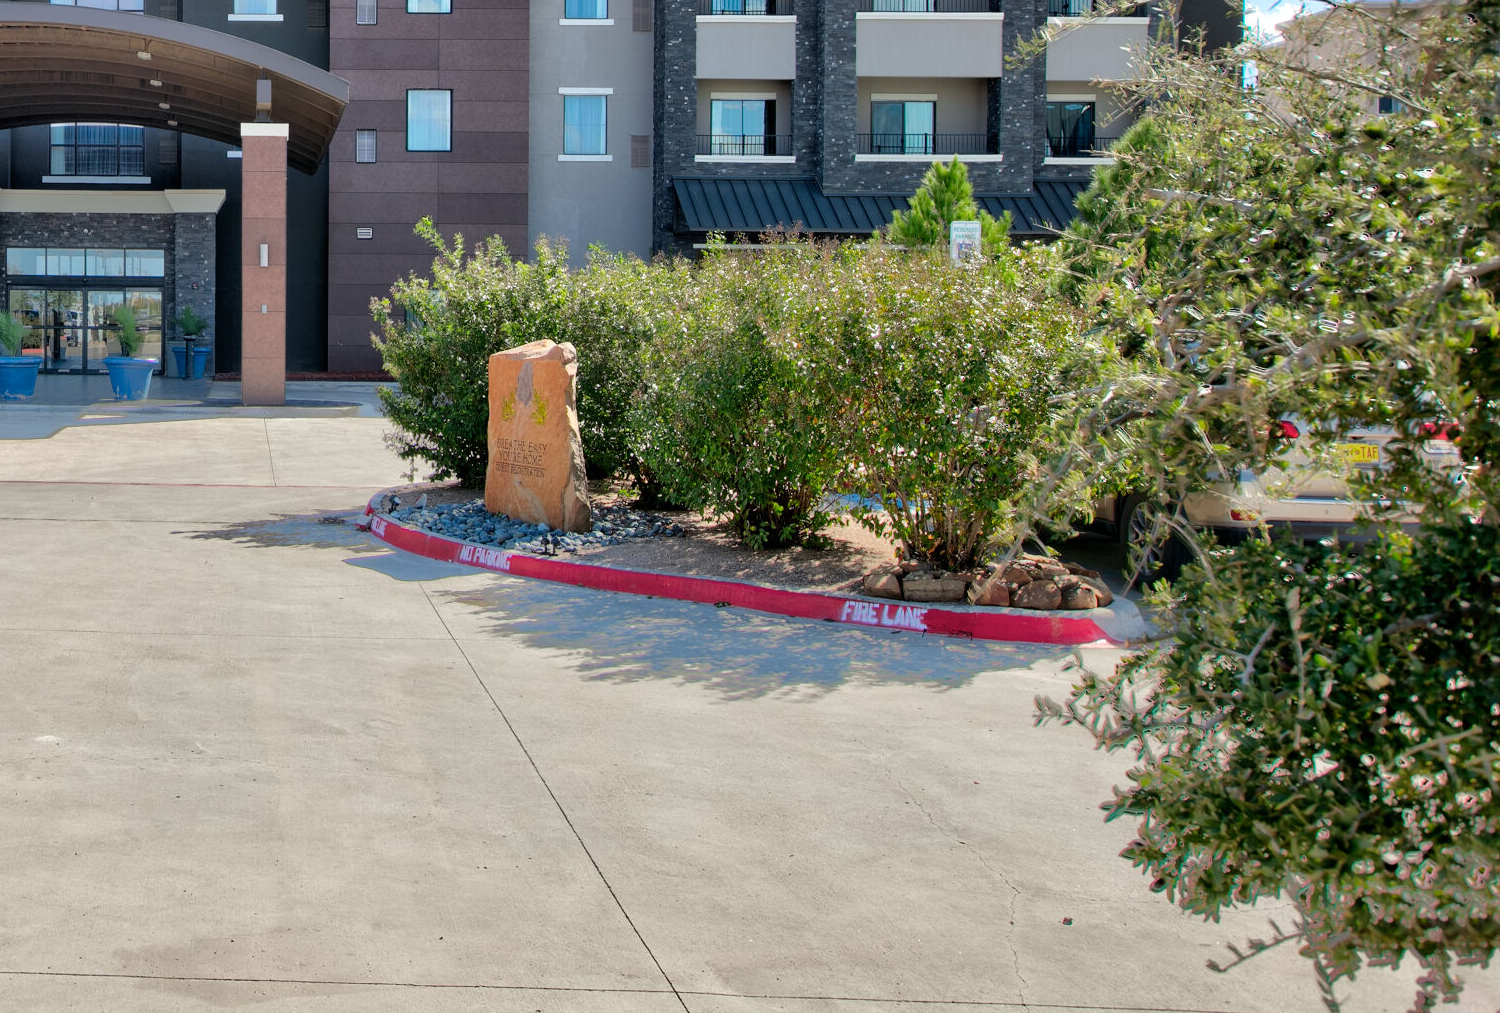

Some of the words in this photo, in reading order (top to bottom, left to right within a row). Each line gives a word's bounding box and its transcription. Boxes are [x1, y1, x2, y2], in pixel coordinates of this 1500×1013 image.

[497, 438, 526, 452] BREATHE
[528, 441, 548, 455] EASY
[522, 453, 543, 467] HOME
[460, 544, 474, 561] NO
[473, 547, 512, 571] PARKING
[841, 600, 880, 624] FIRE
[880, 604, 928, 631] LANE
